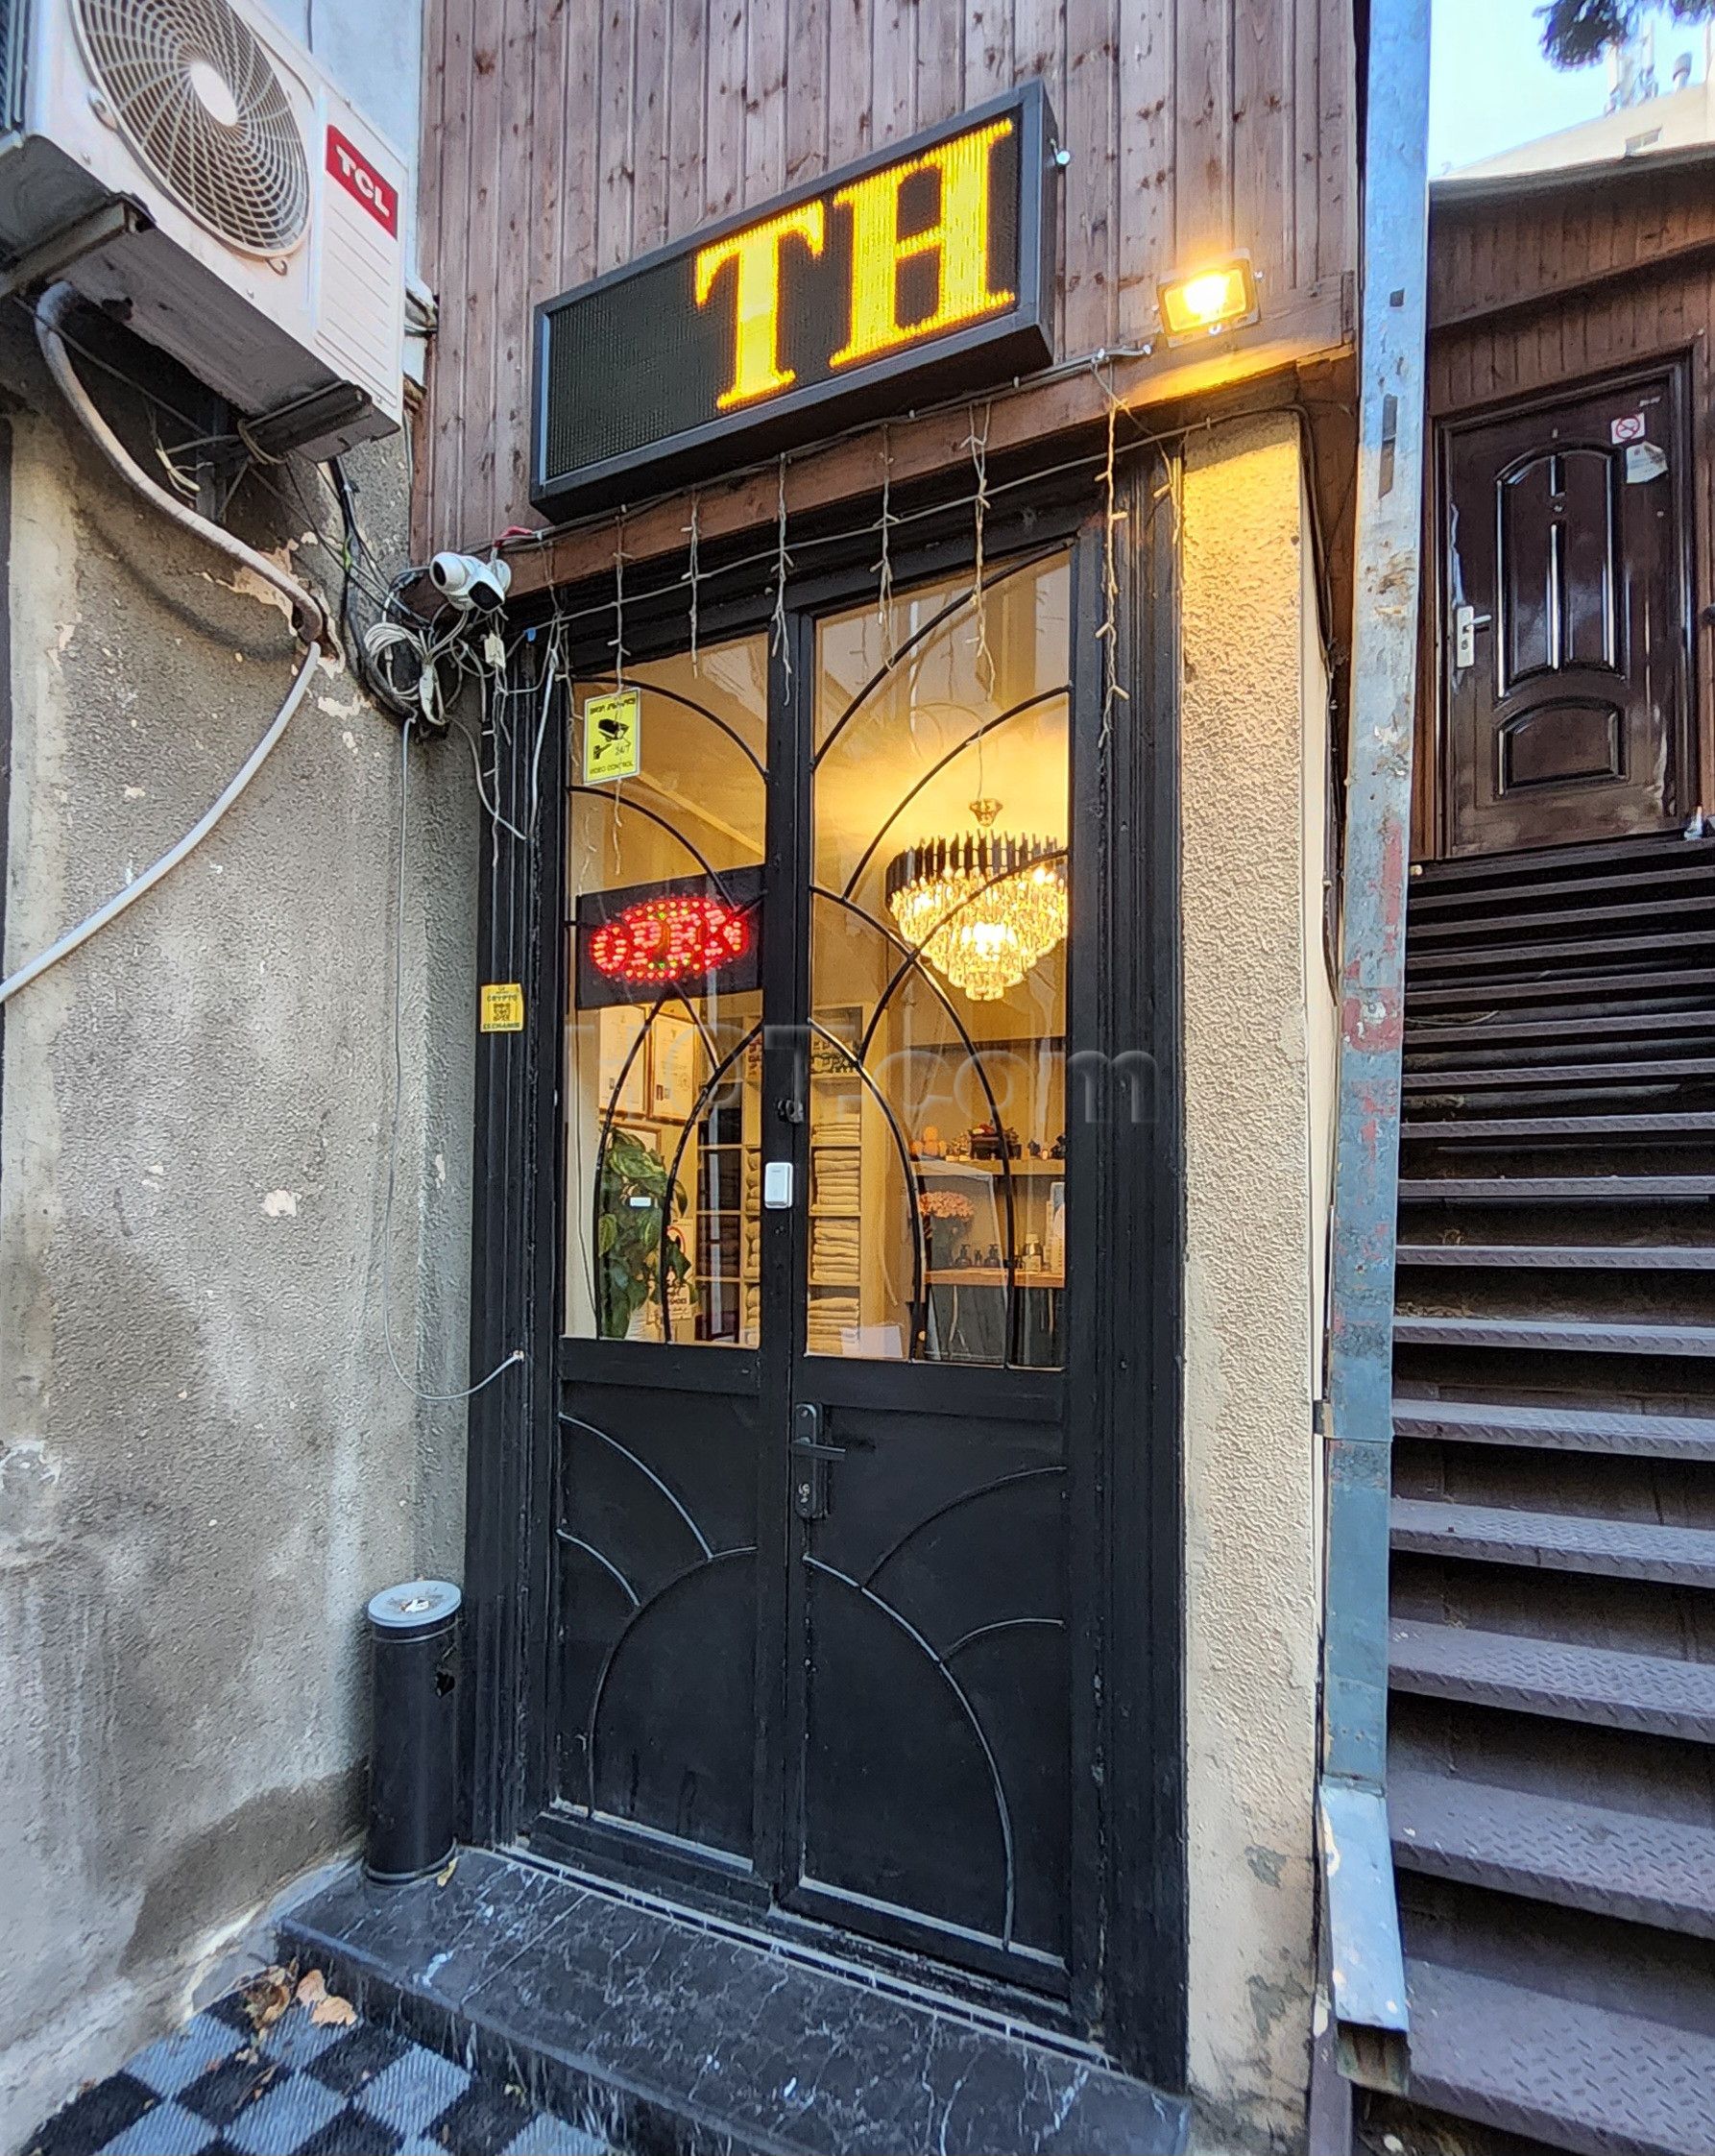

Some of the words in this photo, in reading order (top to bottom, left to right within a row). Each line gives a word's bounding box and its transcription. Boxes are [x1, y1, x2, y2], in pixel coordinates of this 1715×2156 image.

[335, 144, 390, 218] TCL
[694, 117, 1015, 410] TH
[592, 907, 744, 972] OPEN
